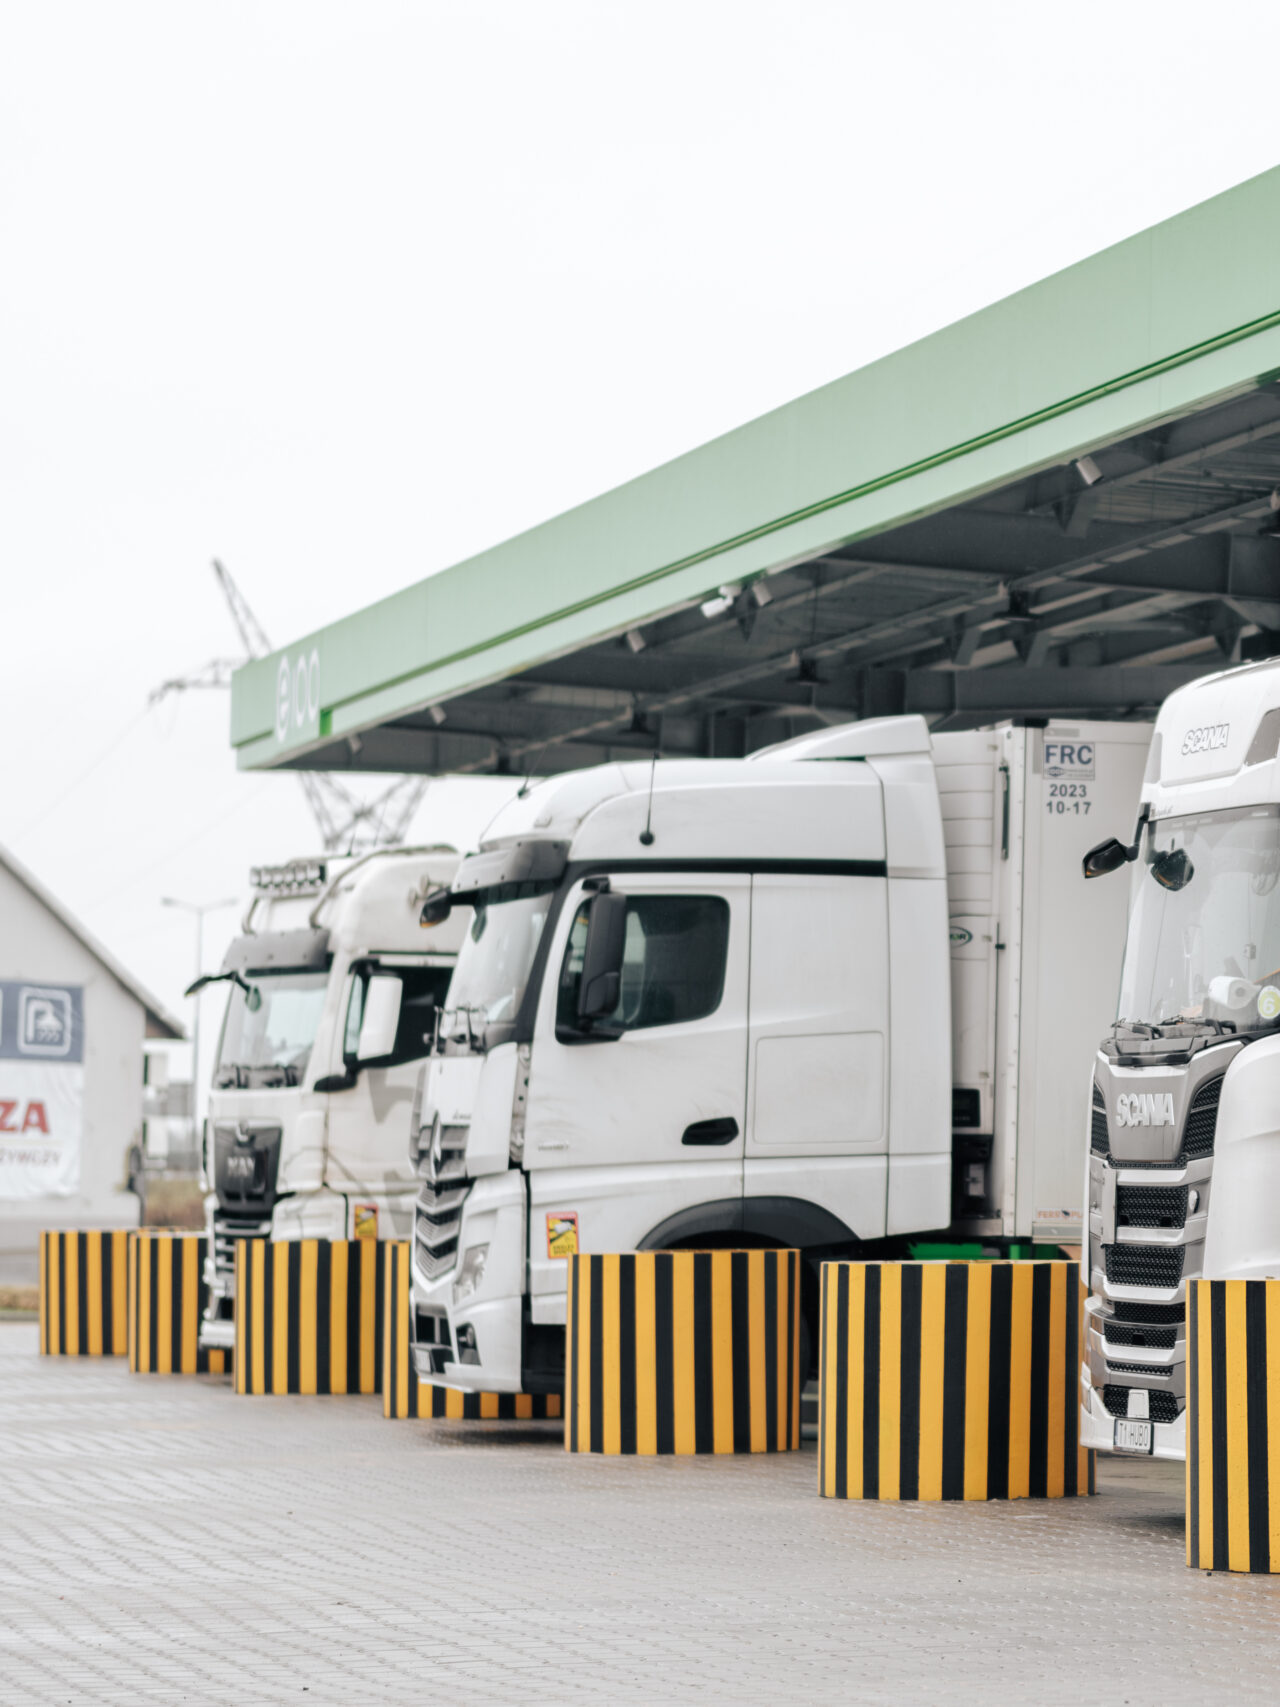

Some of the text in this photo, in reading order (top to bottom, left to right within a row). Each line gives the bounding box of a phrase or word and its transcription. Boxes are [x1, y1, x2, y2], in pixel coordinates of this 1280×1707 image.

[1181, 723, 1230, 756] SCANIA
[1045, 744, 1093, 765] FRC
[1049, 783, 1087, 798] 2023
[1046, 800, 1092, 815] 10-17
[1263, 997, 1275, 1014] 6
[1115, 1092, 1176, 1128] SCANIA
